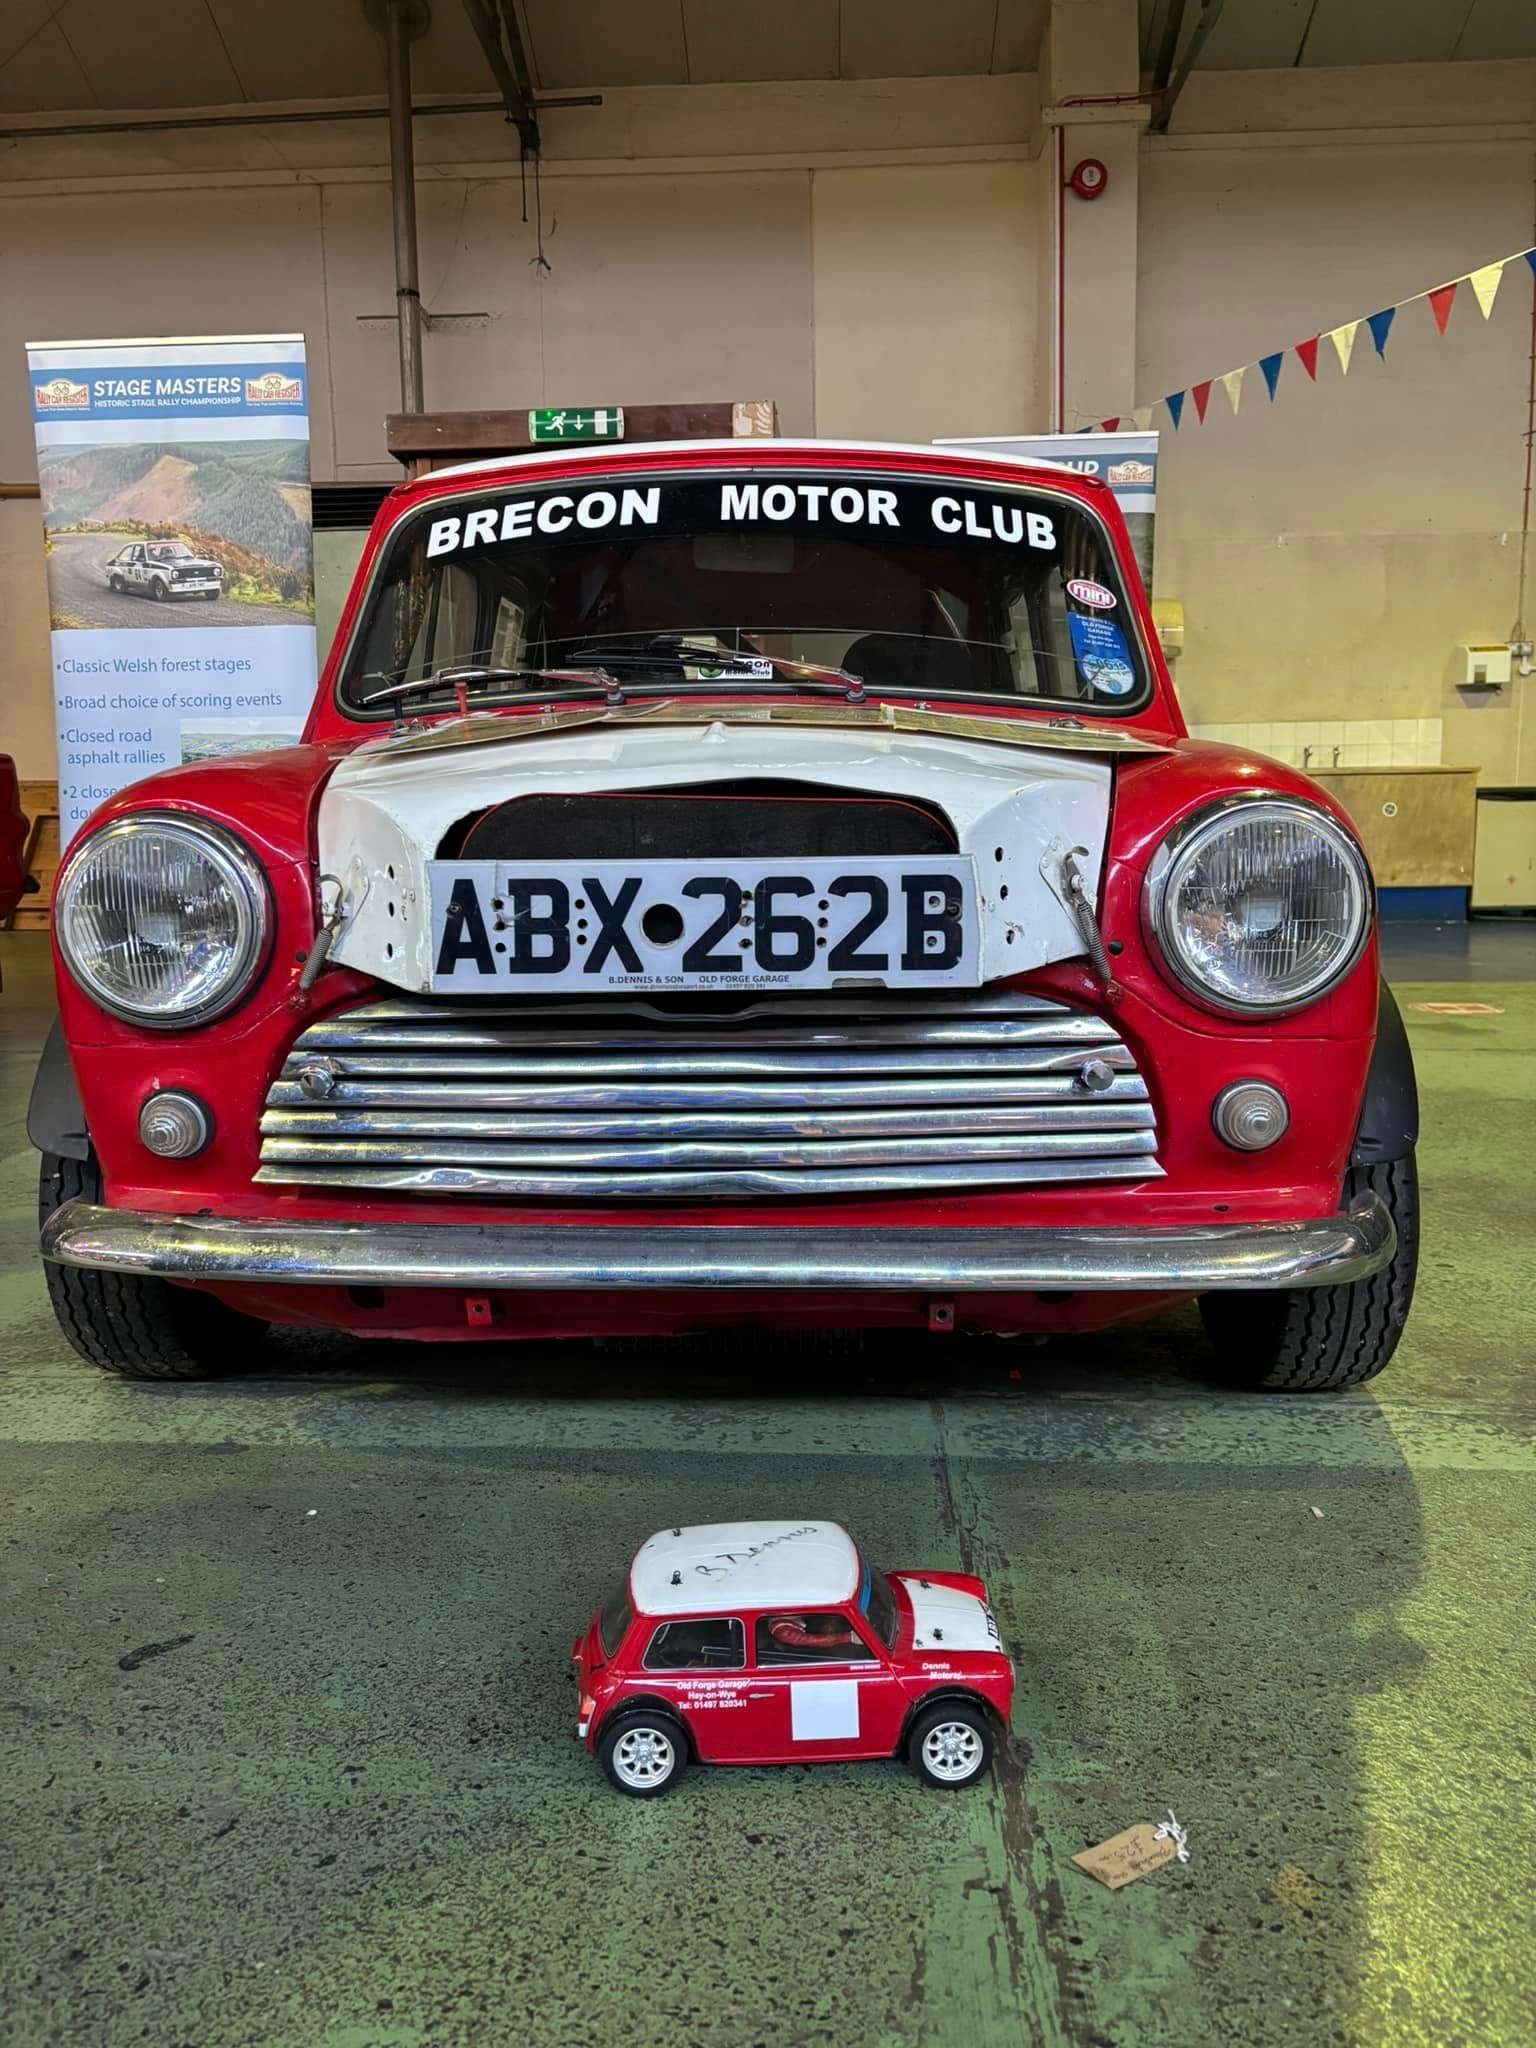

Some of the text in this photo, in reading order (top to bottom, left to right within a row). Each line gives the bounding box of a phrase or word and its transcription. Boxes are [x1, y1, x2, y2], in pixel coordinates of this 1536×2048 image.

[94, 377, 241, 397] STAGE MASTERS
[94, 398, 130, 408] HISTORIC
[131, 397, 156, 407] STAGE
[157, 397, 181, 406] RALLY
[182, 395, 241, 406] CHAMPIONSHIP
[426, 484, 1057, 559] BRECON MOTOR CLUB
[62, 656, 251, 674] Classic Welsh forest stages
[65, 692, 282, 710] Broad choice of scoring events
[66, 728, 152, 743] Closed road
[67, 749, 166, 767] asphalt rallies
[70, 785, 78, 799] 2
[436, 875, 964, 976] ABX 262B
[608, 974, 790, 985] B.DENNIS & SON OLD FORGE GARAGE
[922, 1662, 950, 1670] Dennis
[677, 1680, 749, 1691] Old Forge Garage
[678, 1702, 692, 1710] Tel:
[694, 1701, 717, 1709] 01497
